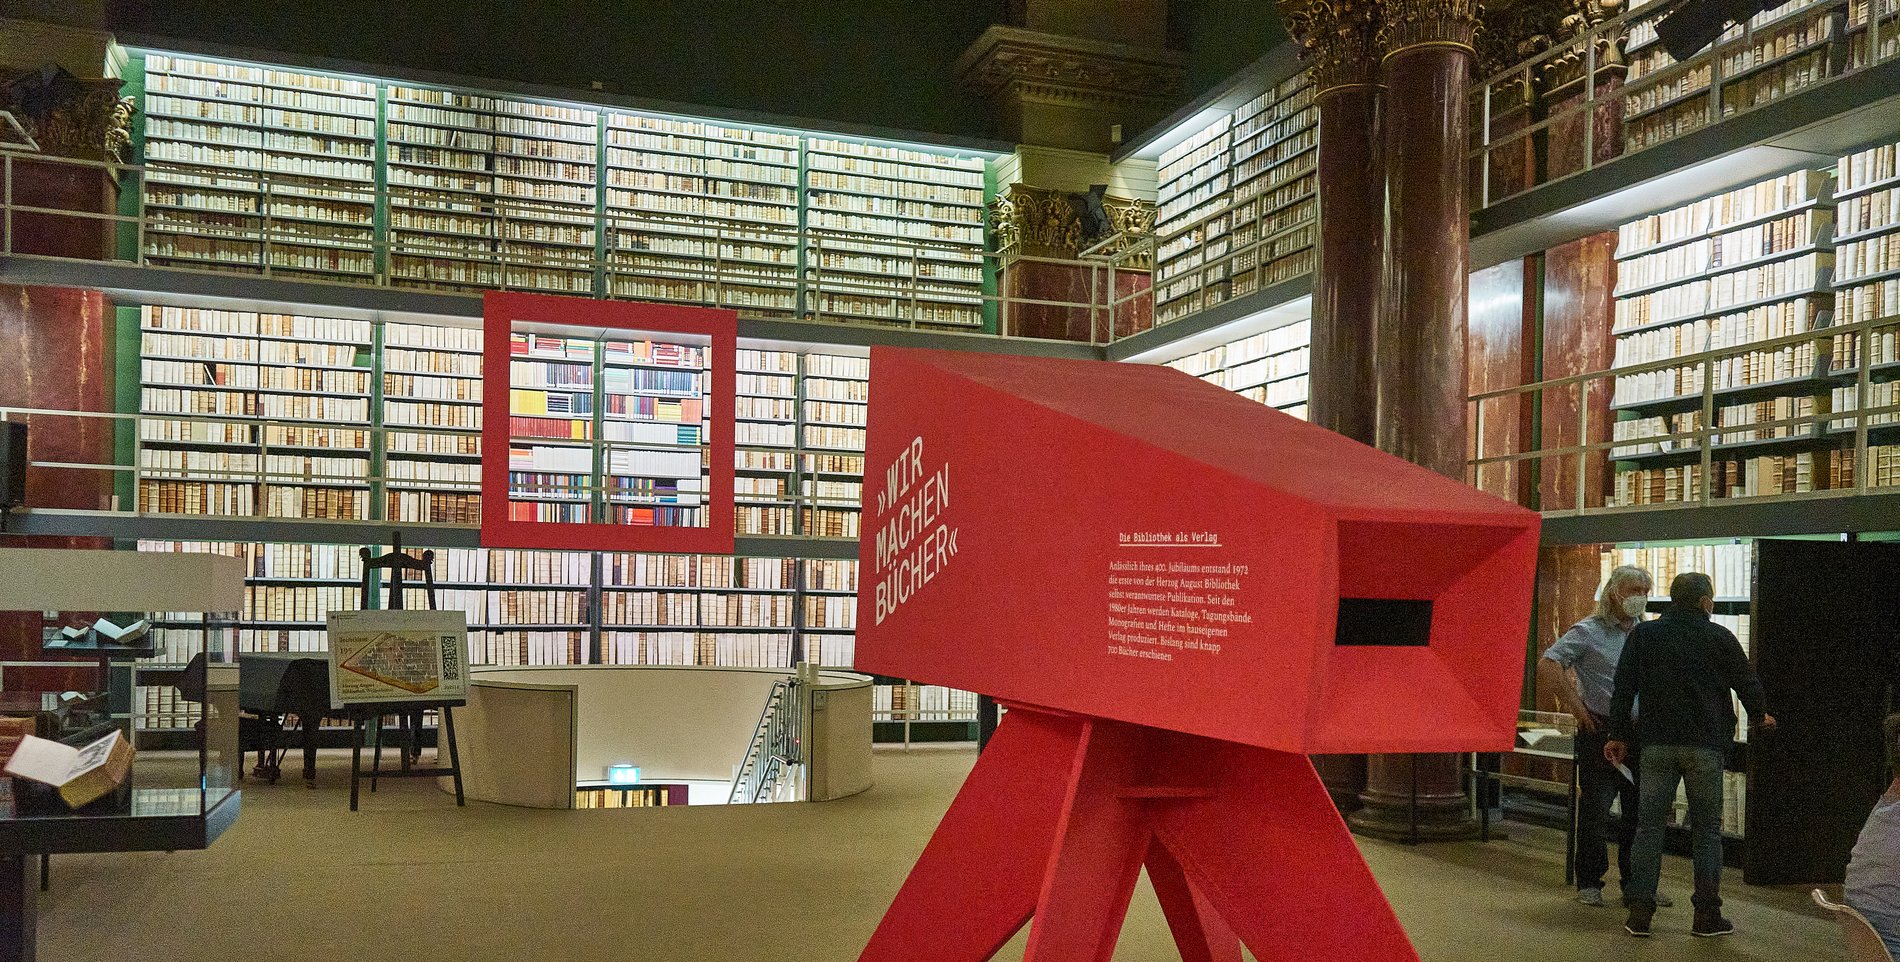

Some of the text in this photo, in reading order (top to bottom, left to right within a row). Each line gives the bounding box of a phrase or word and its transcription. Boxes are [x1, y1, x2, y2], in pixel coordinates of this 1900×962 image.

[877, 436, 923, 517] »WIR
[876, 462, 949, 574] MACHEN
[1119, 531, 1218, 544] Die Bibliothek als Verlag
[876, 524, 958, 626] BÜCHER«
[1109, 561, 1138, 571] Anlässlich
[1139, 562, 1154, 571] ihres
[1168, 562, 1200, 573] Jubiläums
[1201, 563, 1231, 574] entstand
[1232, 565, 1249, 576] 1972
[1108, 574, 1241, 591] die erste von der Herzog August Bibliothek
[1108, 588, 1236, 606] selbst verantwortete Publikation. Seit den
[1109, 603, 1126, 613] 1980er
[1127, 604, 1147, 615] Jahren
[1147, 606, 1170, 617] werden
[1170, 606, 1201, 620] Kataloge,
[1108, 616, 1228, 638] Monografien und Hefte im hauseigenen
[1108, 630, 1127, 643] Verlag
[1160, 635, 1184, 649] Bislang
[1184, 638, 1199, 650] sind
[1200, 638, 1221, 655] knapp
[1108, 645, 1173, 661] 700 Bücher erschienen.
